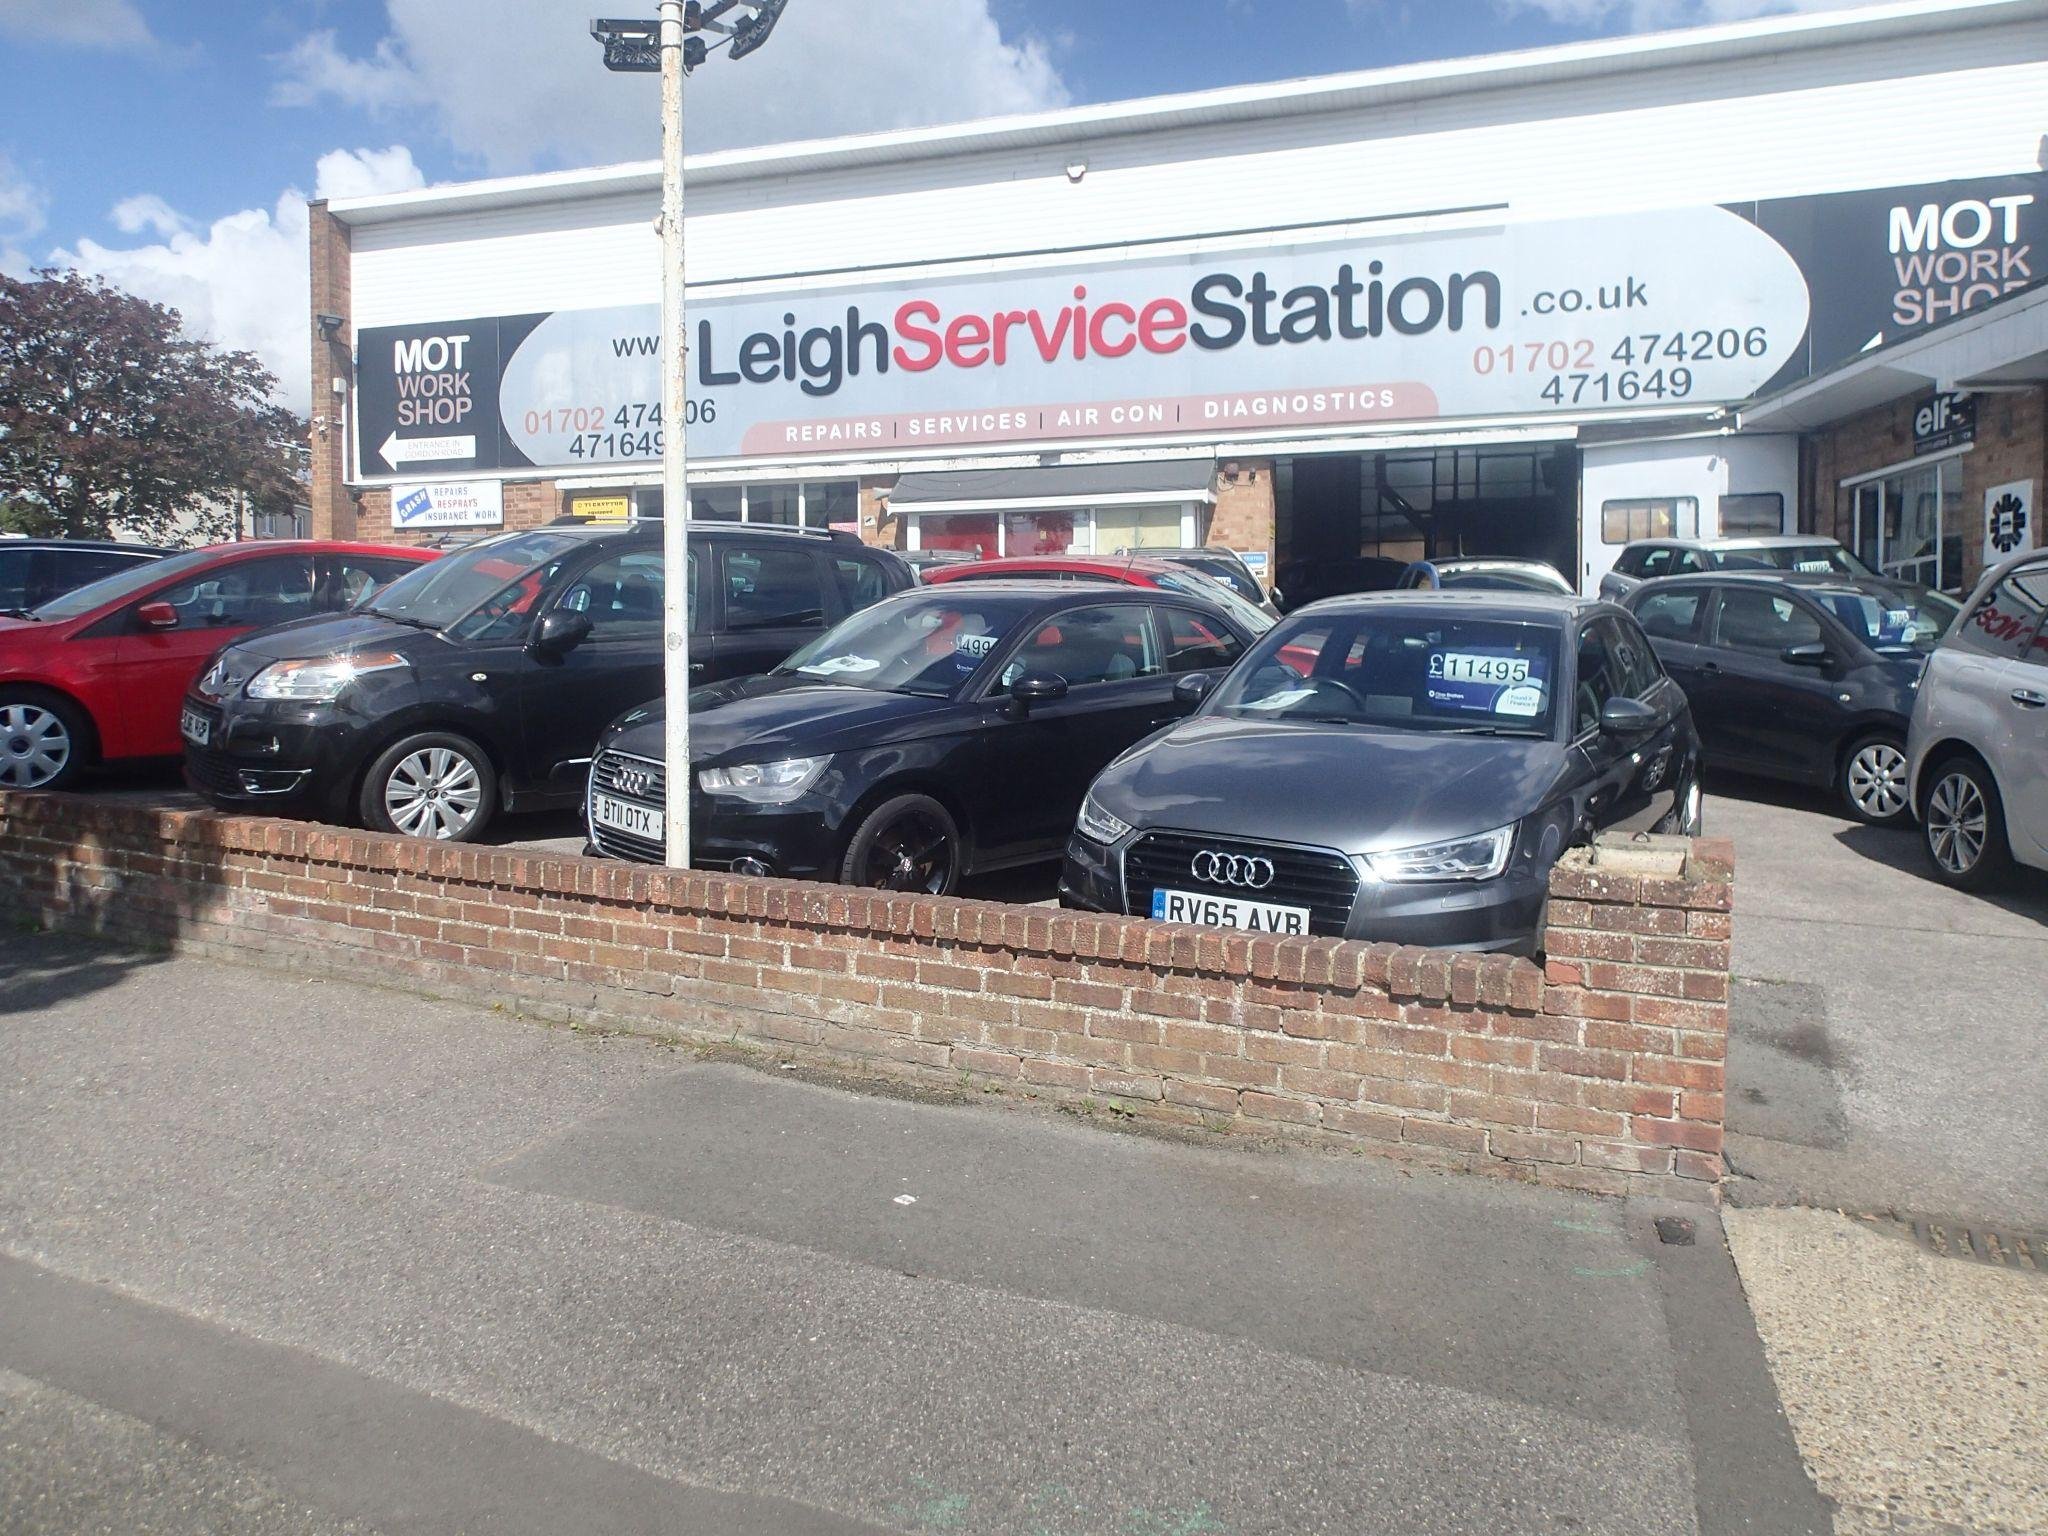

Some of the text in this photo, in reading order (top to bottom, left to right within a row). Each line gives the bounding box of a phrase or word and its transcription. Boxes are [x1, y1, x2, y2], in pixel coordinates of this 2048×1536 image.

[1889, 194, 2034, 254] MOT
[1894, 245, 2031, 287] WORK
[1521, 276, 1648, 316] .co.uk
[1893, 280, 2029, 325] SHO
[394, 334, 471, 374] MOT
[1473, 327, 1767, 375] 01702 474206
[397, 372, 471, 398] WORK
[1540, 367, 1692, 404] 471649
[398, 397, 473, 426] SHOP
[525, 399, 716, 435] 01702 47406
[786, 389, 1395, 443] REPAIRS SERVICES AIR CON DIAGNOSTICS
[1915, 396, 1950, 436] elf
[407, 440, 450, 450] ENTRANCE
[399, 489, 428, 518] CRASH
[434, 487, 469, 496] REPAIRS
[425, 510, 498, 521] INSURANCE WORK
[1169, 895, 1238, 928] RV65
